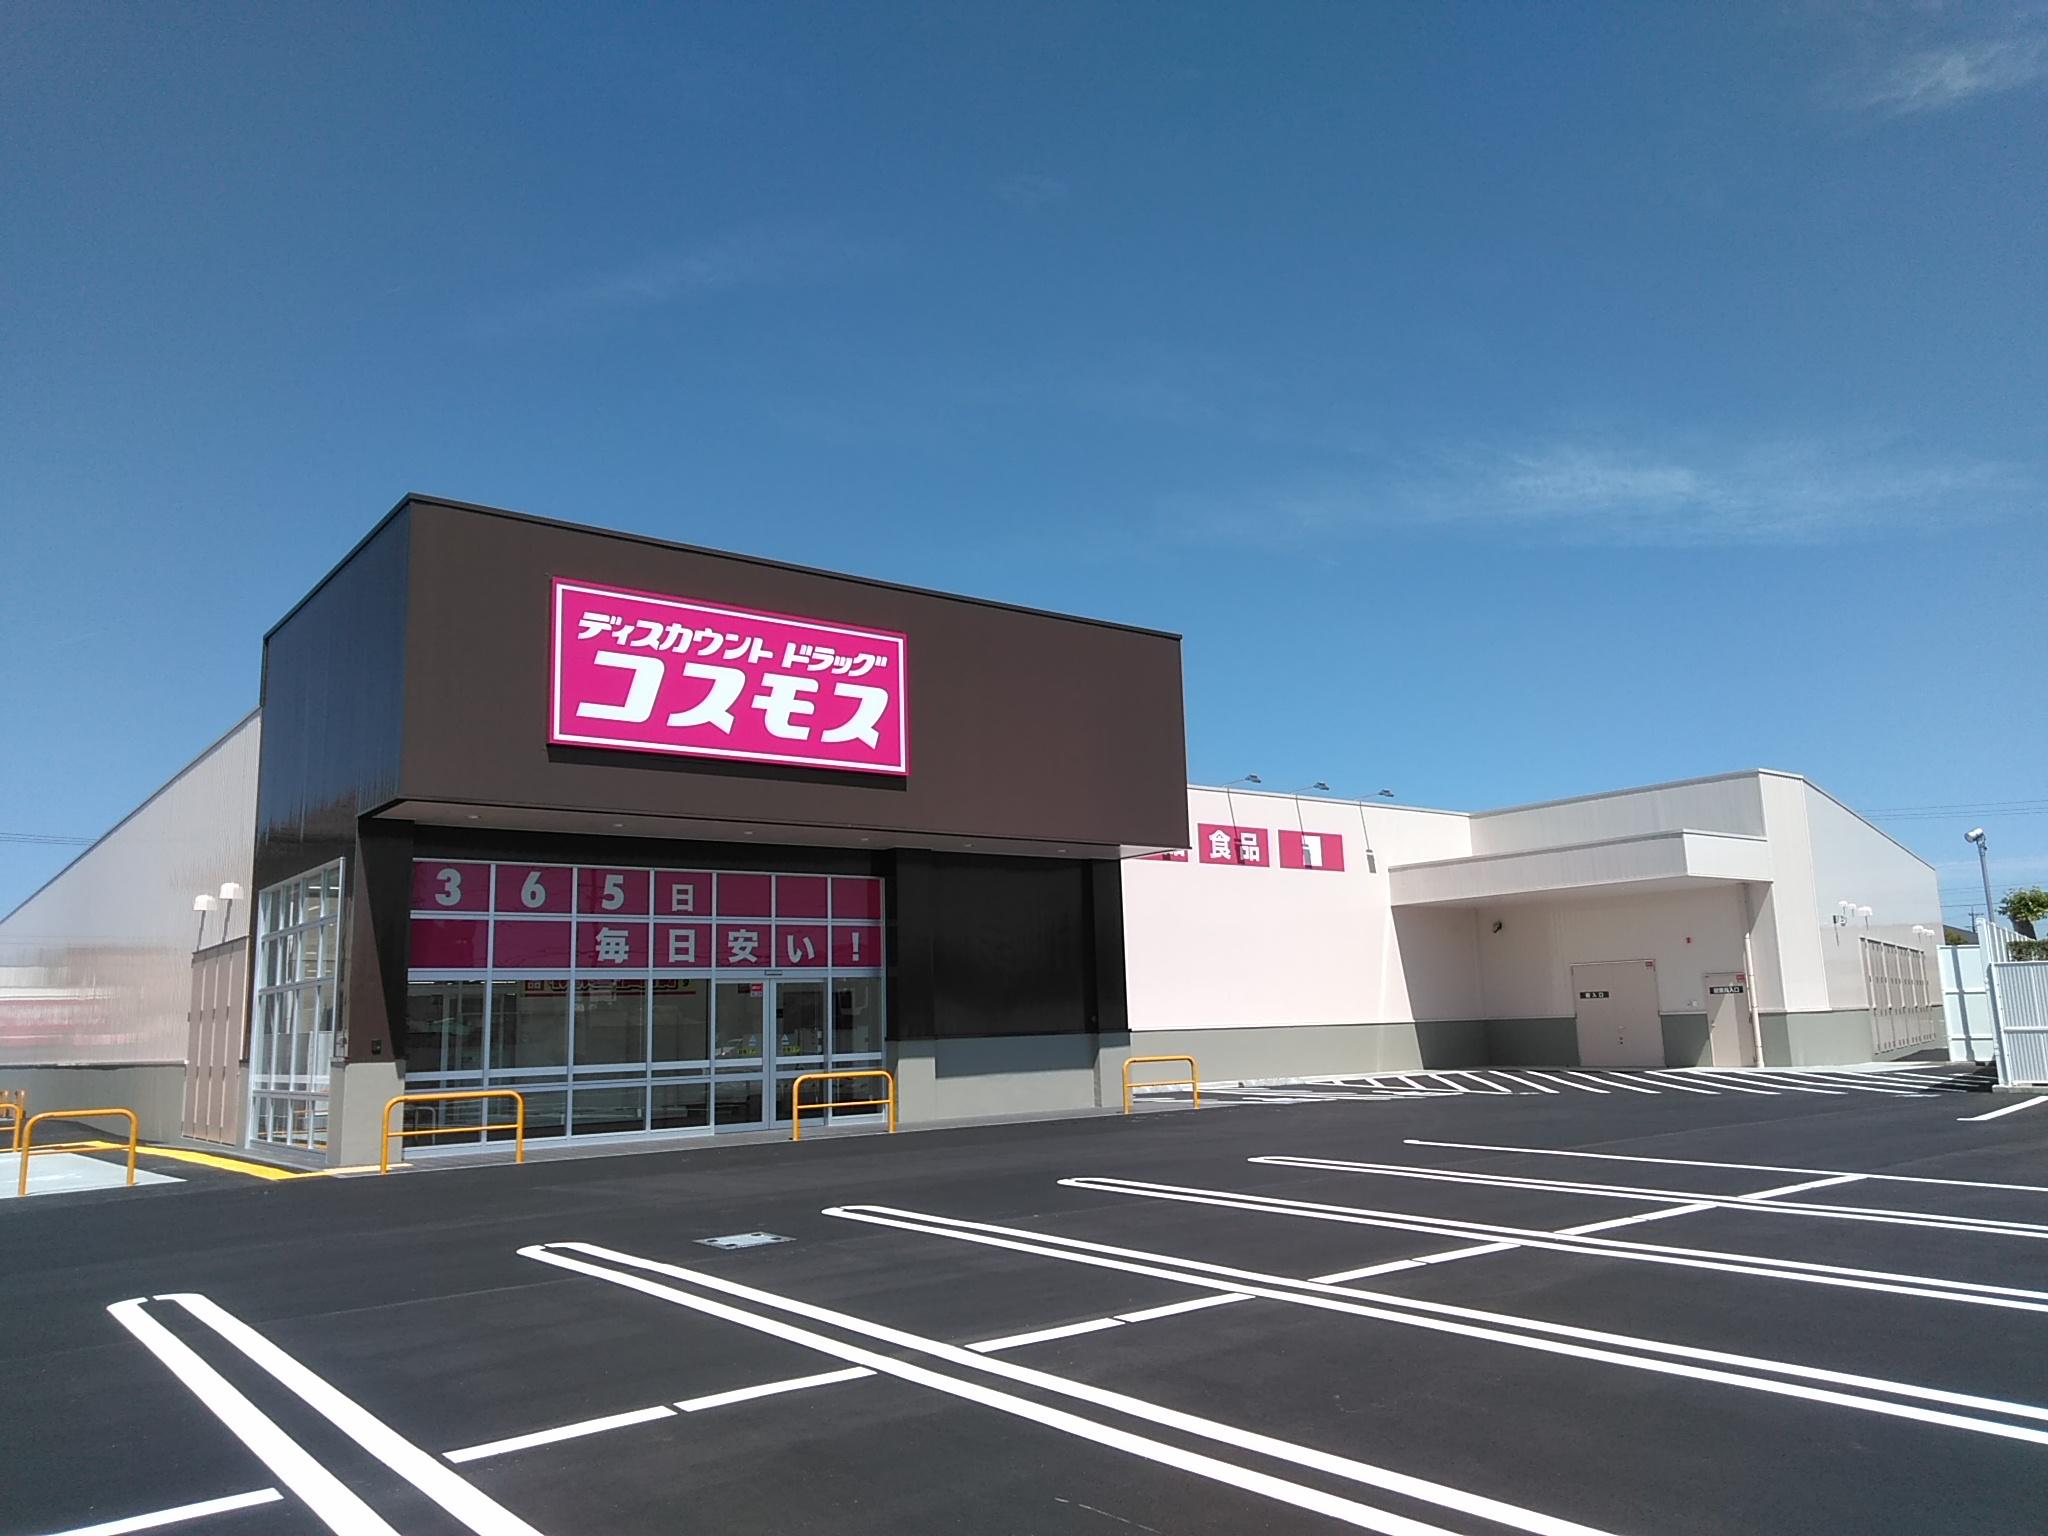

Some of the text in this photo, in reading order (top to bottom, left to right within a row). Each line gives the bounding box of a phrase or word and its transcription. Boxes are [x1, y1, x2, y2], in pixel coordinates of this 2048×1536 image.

[577, 611, 888, 677] ディスカウント ドラッグ
[575, 650, 889, 750] コスモス
[1208, 829, 1260, 862] 食品
